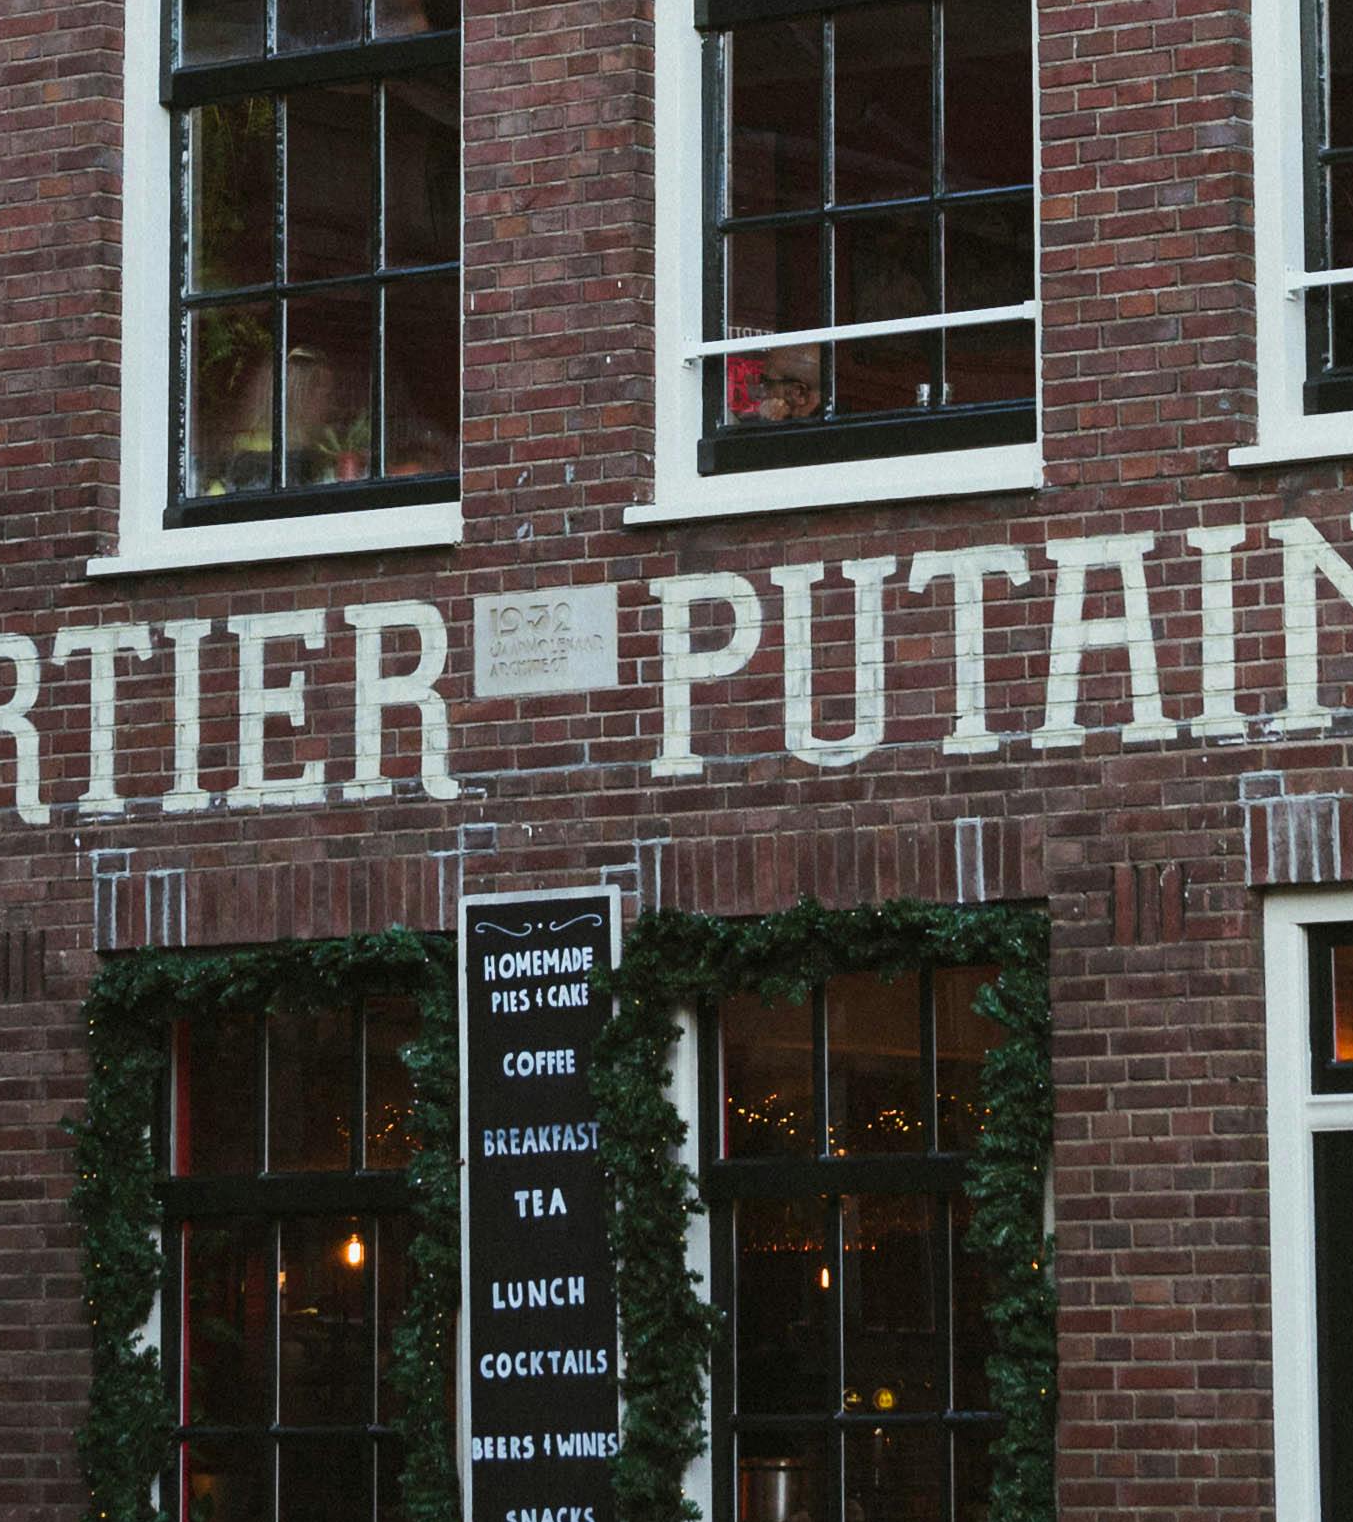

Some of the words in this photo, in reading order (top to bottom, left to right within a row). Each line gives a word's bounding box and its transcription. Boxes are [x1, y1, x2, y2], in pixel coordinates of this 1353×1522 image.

[484, 946, 594, 981] HOMEMADE
[491, 989, 531, 1014] PIES
[547, 983, 589, 1007] CAKE
[502, 1049, 576, 1076] COFFEE
[483, 1121, 600, 1158] BREAKFAST
[514, 1187, 567, 1218] TEA
[492, 1276, 586, 1310] LUNCH
[479, 1349, 608, 1379] COCKTAILS
[471, 1434, 535, 1462] BEERS
[556, 1432, 619, 1458] WINES
